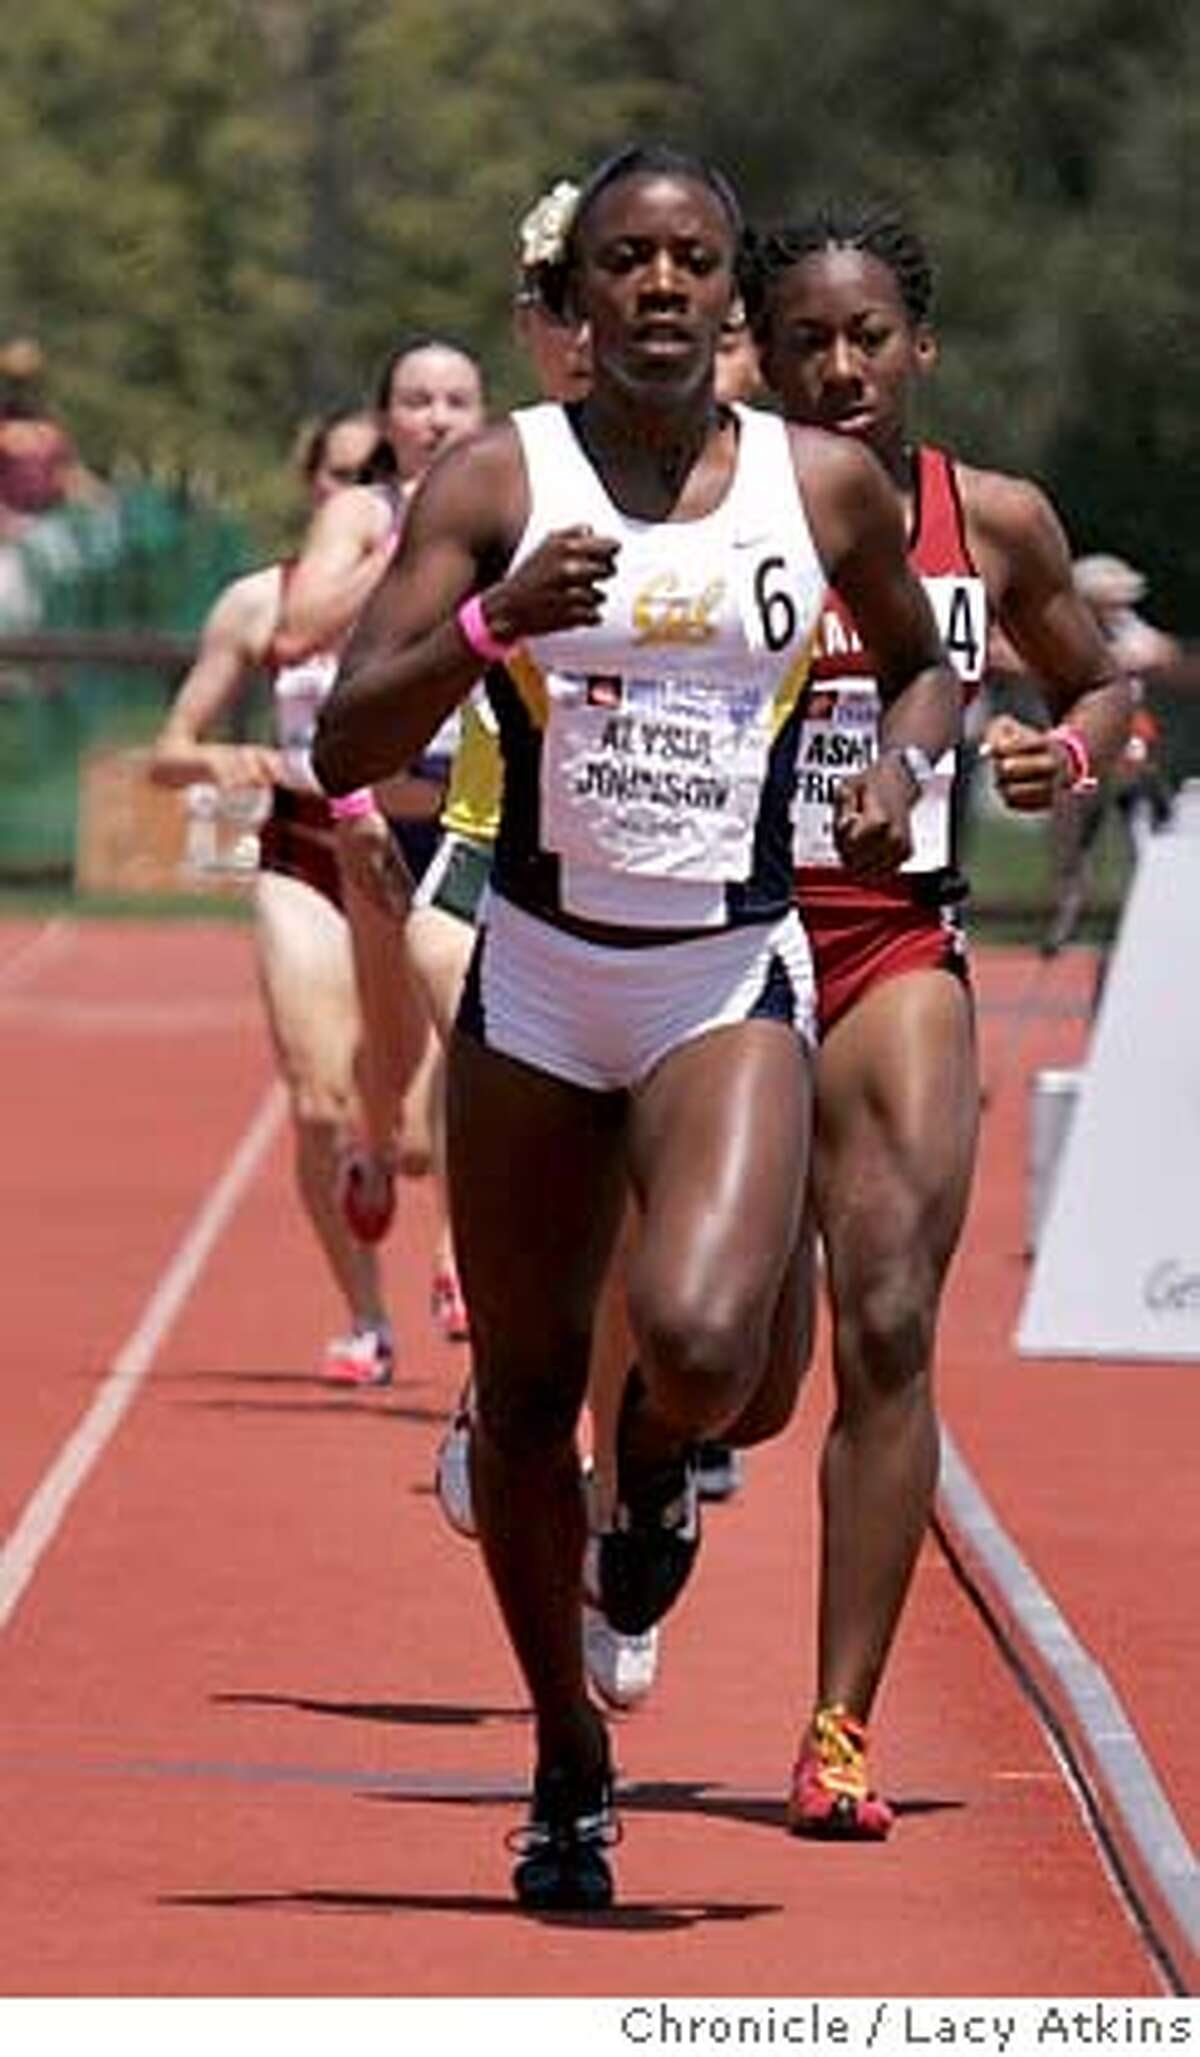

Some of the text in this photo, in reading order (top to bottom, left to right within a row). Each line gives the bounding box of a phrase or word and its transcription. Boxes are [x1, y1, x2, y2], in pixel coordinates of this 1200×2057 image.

[755, 556, 795, 652] 6
[948, 587, 977, 670] 4
[574, 762, 729, 810] JOHNSON
